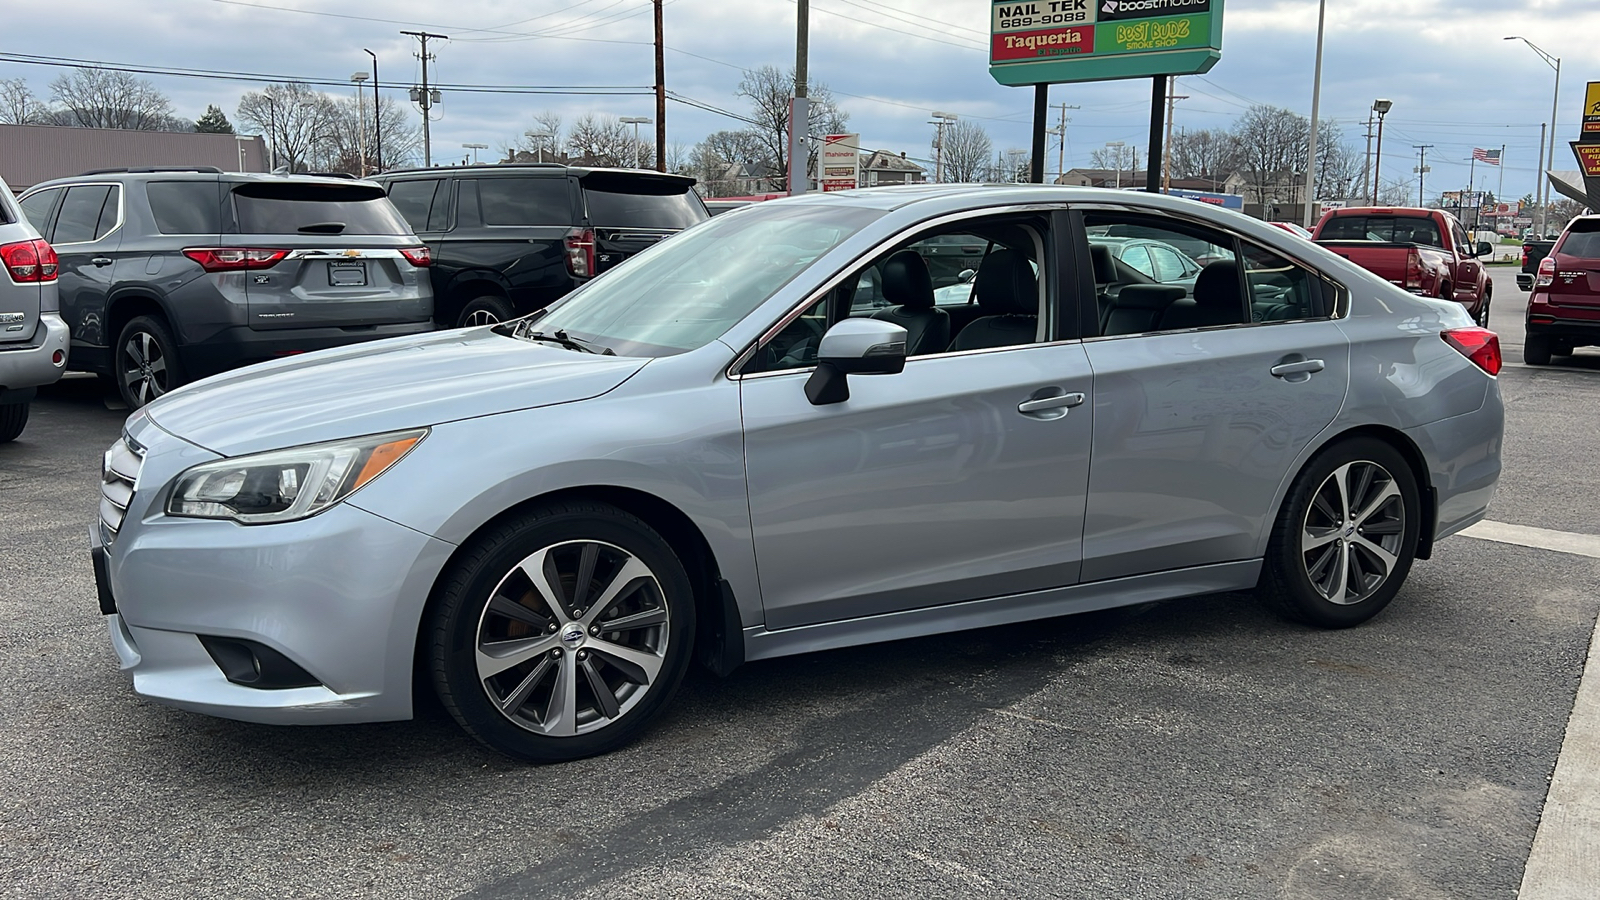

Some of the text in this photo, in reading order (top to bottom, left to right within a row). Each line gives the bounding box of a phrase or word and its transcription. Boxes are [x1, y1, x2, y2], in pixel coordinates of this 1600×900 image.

[999, 0, 1087, 18] NAIL TEK
[1001, 12, 1086, 28] 689-9088
[1126, 39, 1178, 50] SMOKE SHOP
